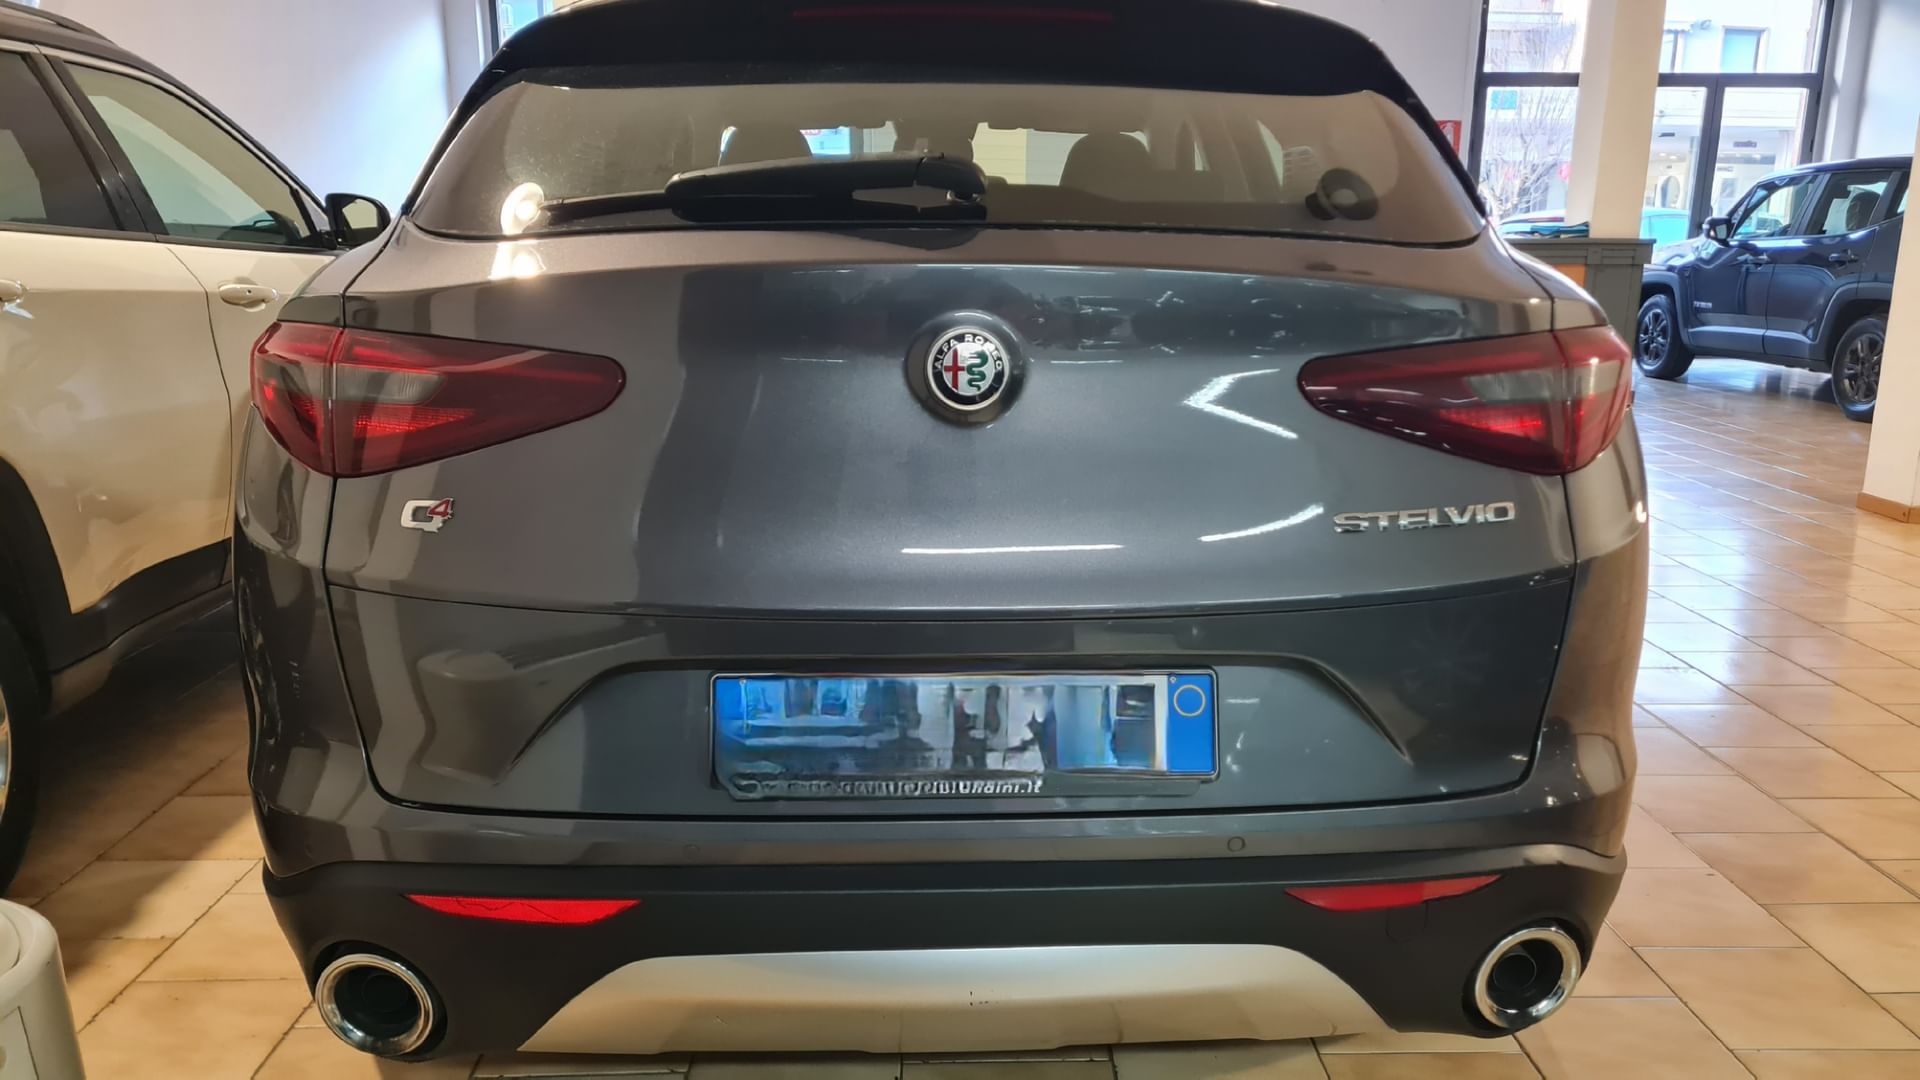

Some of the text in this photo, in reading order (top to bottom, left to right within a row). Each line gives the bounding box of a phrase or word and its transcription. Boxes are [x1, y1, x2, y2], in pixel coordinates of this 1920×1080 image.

[934, 338, 959, 369] ALFA
[401, 498, 453, 533] Q4
[1333, 501, 1516, 533] STELVIO
